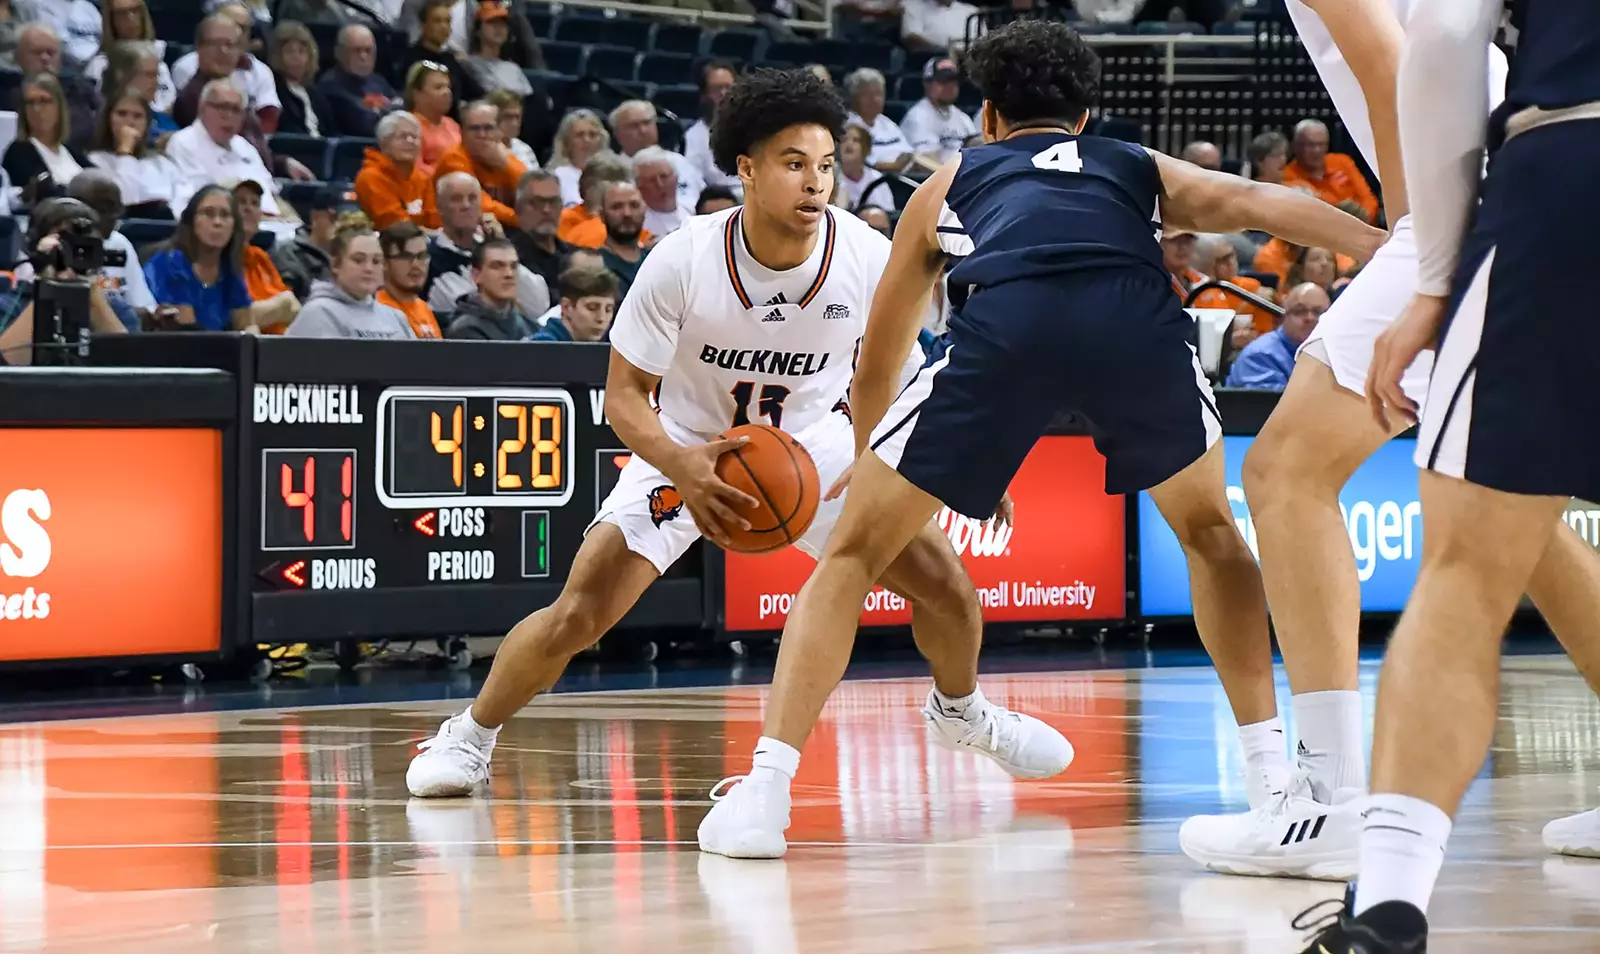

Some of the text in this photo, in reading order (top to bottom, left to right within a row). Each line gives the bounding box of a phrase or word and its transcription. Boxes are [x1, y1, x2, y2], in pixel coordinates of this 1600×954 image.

[1031, 140, 1083, 173] 4
[699, 344, 830, 376] BUCKNELL
[253, 383, 363, 424] BUCKNELL
[280, 455, 353, 543] 41
[438, 507, 485, 537] POSS
[538, 516, 546, 570] 1
[311, 558, 376, 589] BONUS
[427, 550, 495, 581] PERIOD
[1012, 579, 1096, 610] University
